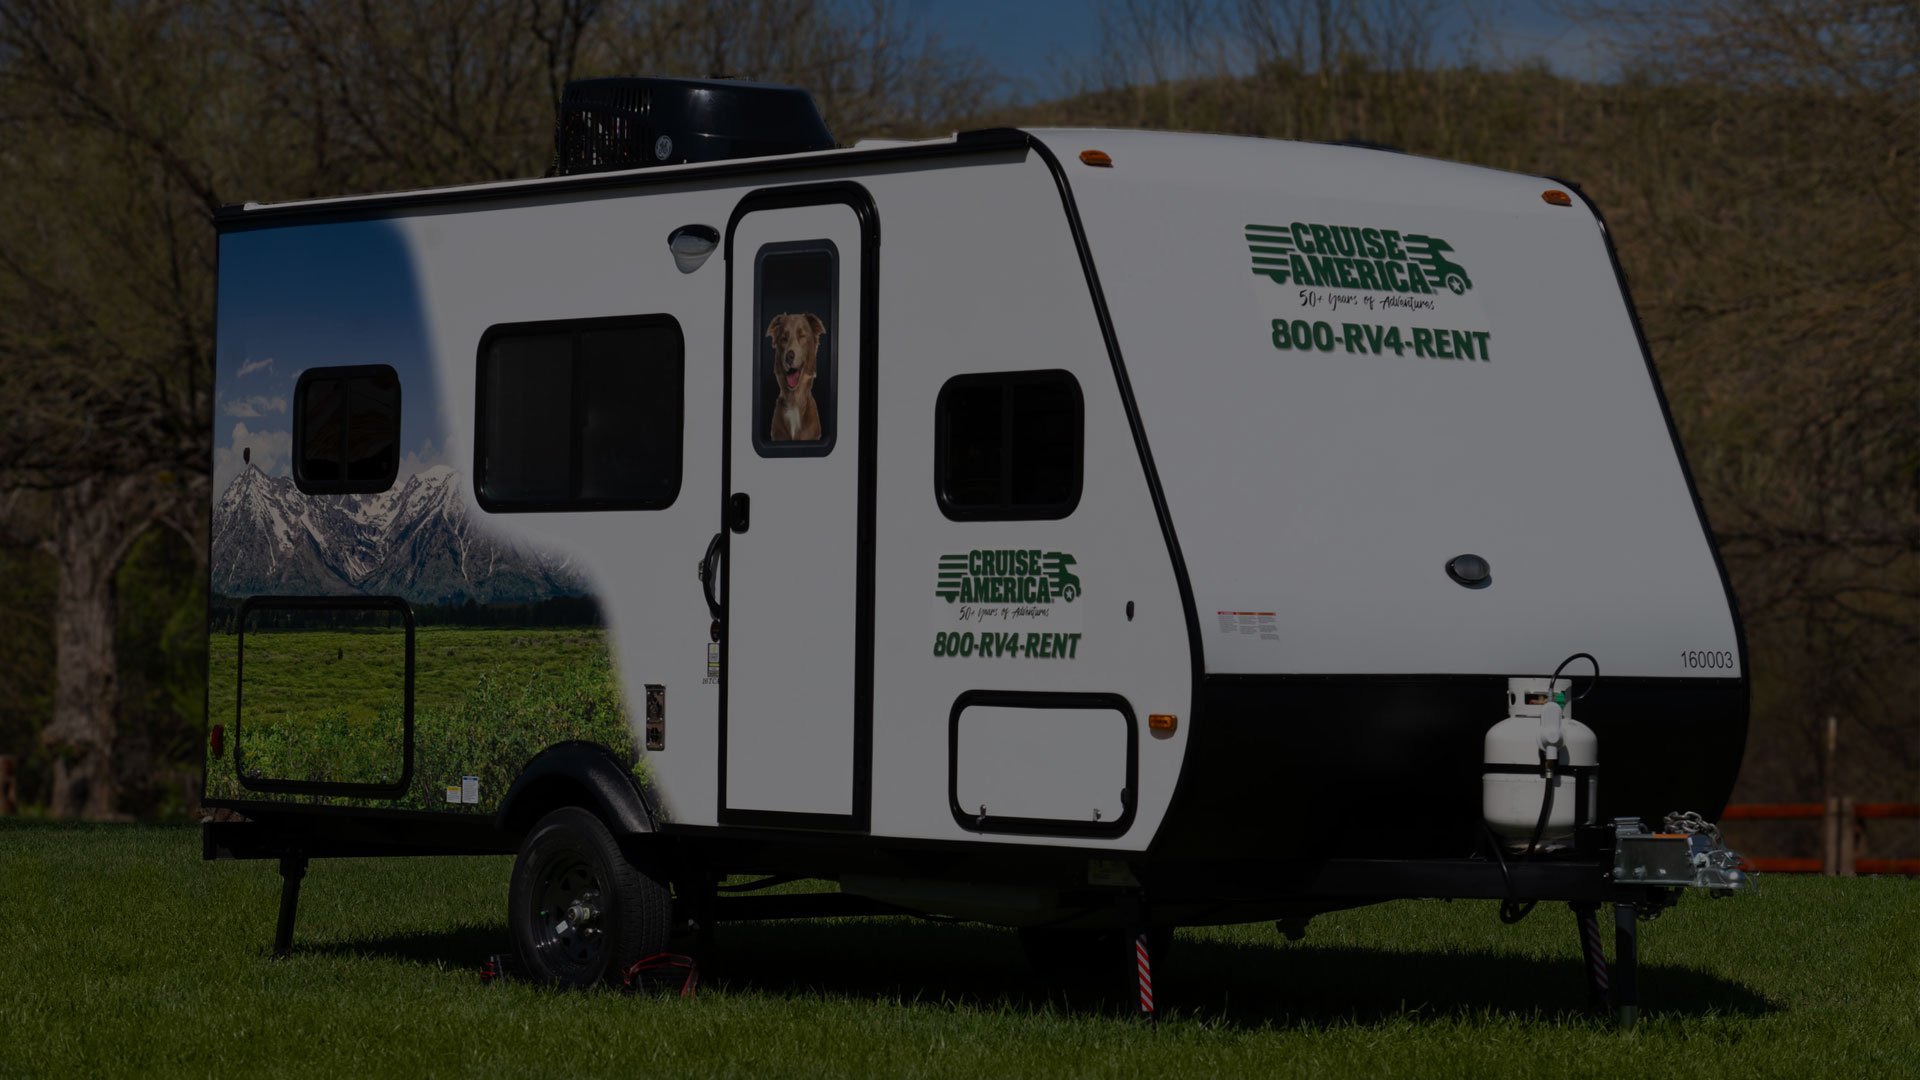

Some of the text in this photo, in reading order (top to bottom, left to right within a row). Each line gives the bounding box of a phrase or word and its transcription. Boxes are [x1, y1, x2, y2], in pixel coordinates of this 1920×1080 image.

[1290, 222, 1407, 261] CRUISE
[1290, 254, 1432, 294] AMERICA
[1299, 290, 1323, 307] 50+
[1363, 294, 1375, 310] of
[1380, 295, 1435, 311] Adventures
[1271, 318, 1491, 362] 800-RV4-RENT
[969, 549, 1042, 576] CRUISE
[959, 576, 1051, 603] AMERICA
[933, 631, 1082, 658] 800-RV4-RENT
[1681, 651, 1734, 668] 160003
